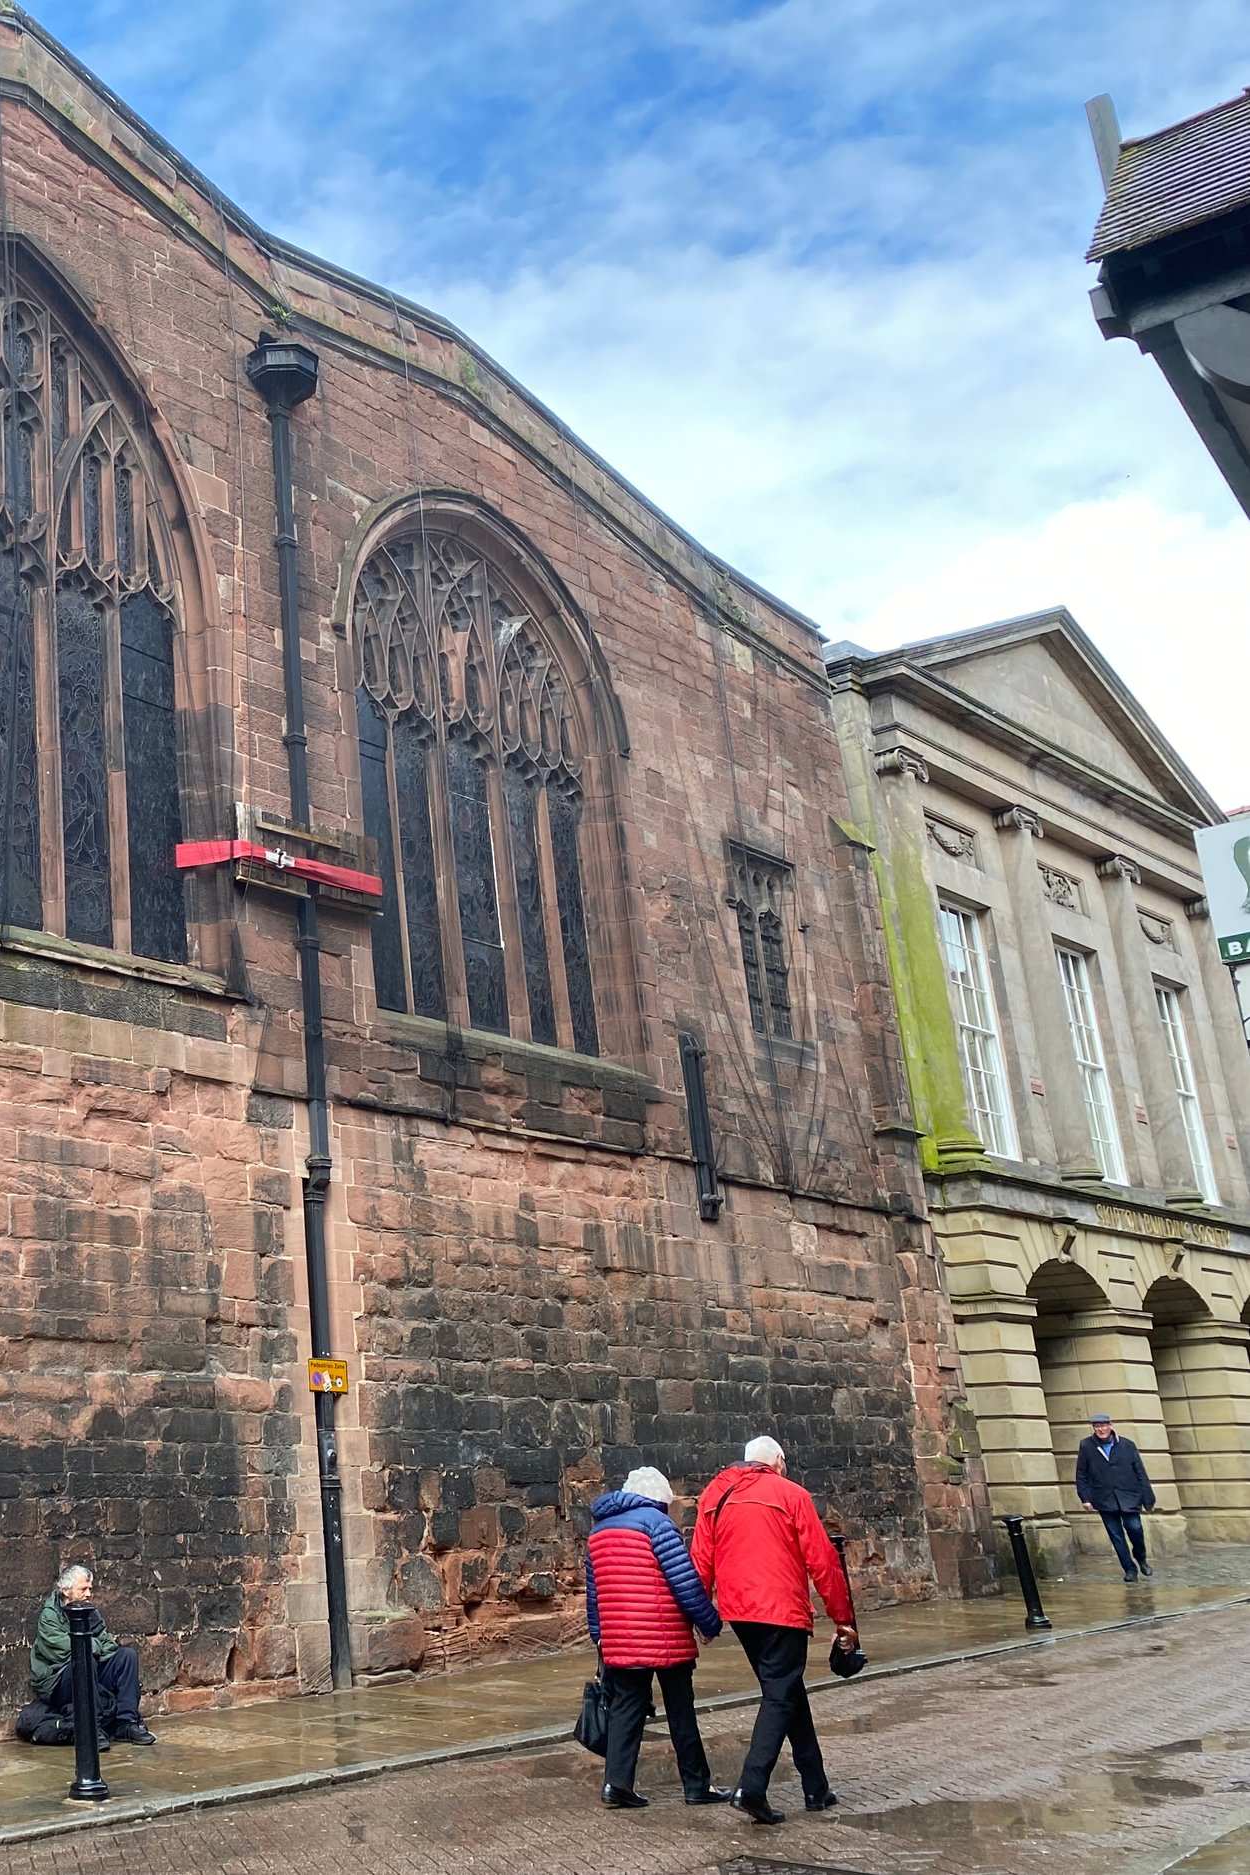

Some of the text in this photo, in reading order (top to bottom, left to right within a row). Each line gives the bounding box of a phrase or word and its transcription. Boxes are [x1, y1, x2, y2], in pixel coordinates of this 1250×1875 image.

[1096, 1203, 1231, 1249] SKIPTON BUILDING SOCIETY
